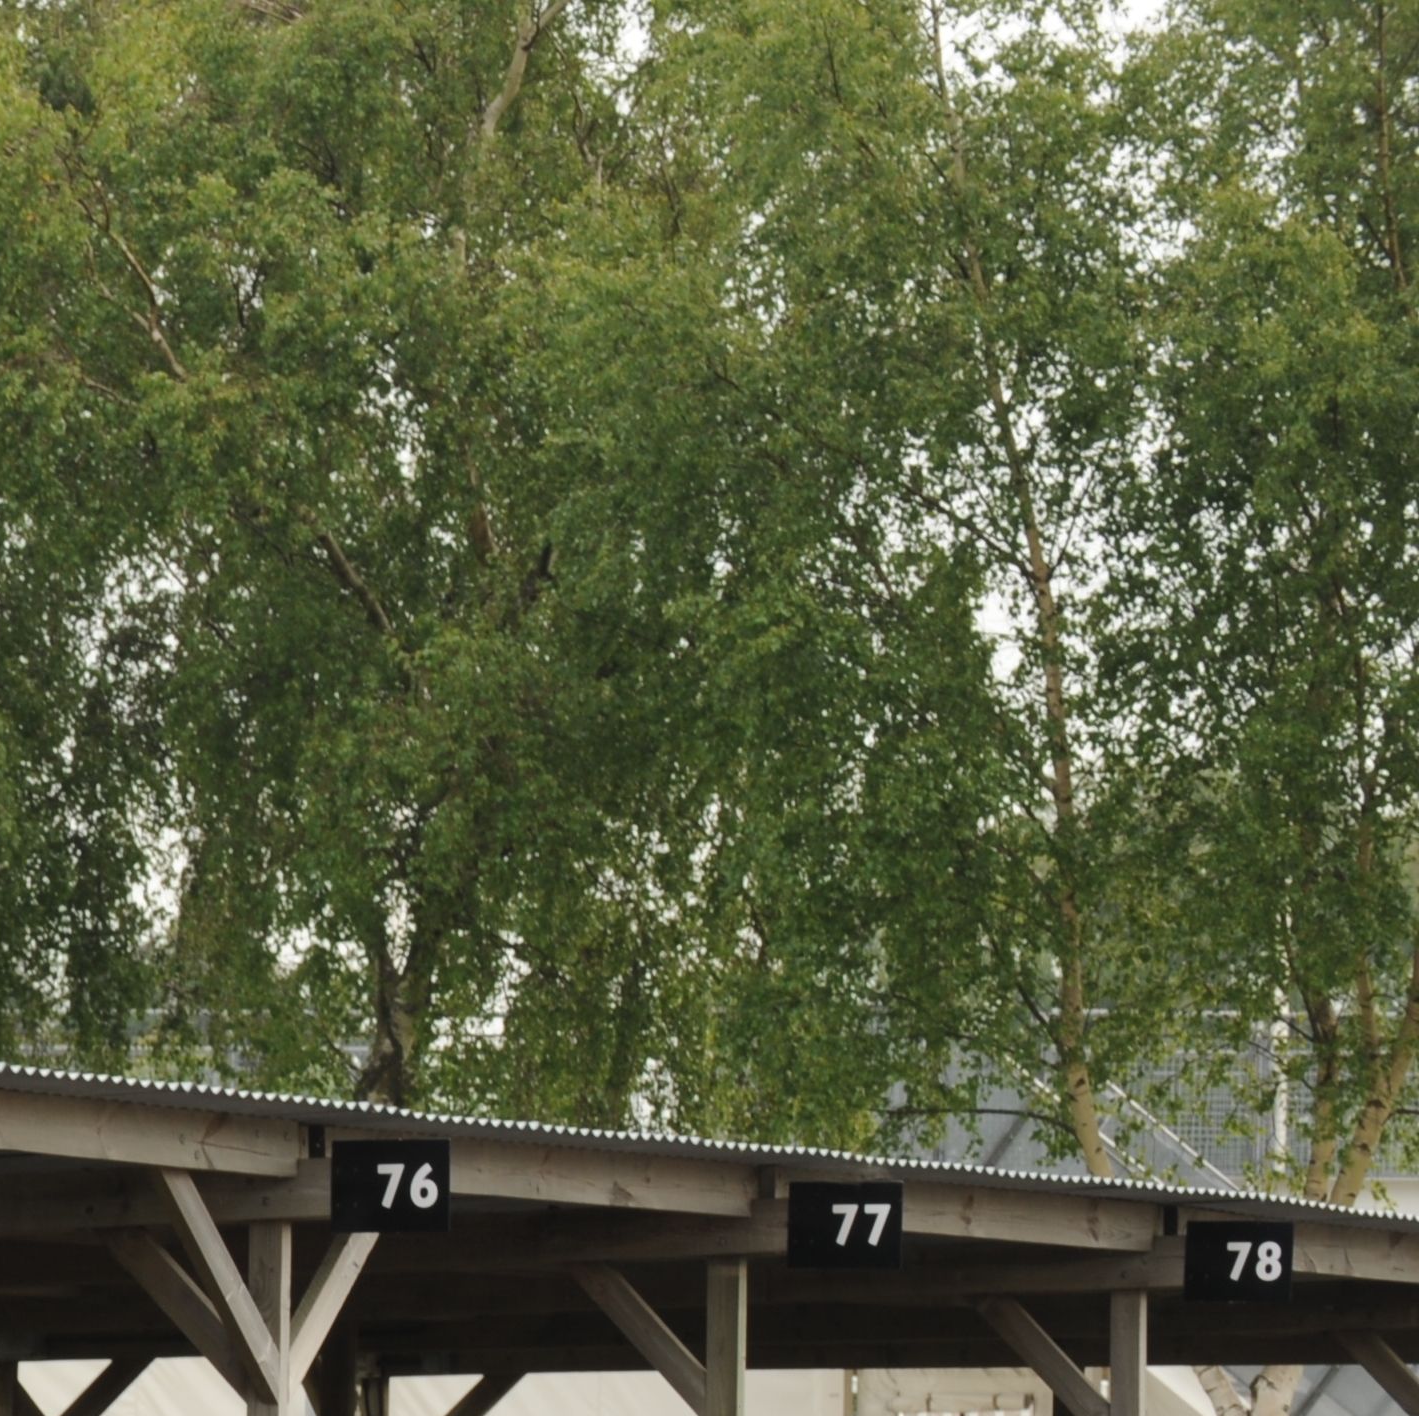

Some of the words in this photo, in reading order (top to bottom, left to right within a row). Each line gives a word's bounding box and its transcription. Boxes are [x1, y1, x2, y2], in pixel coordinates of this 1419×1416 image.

[377, 1162, 439, 1209] 76
[832, 1203, 892, 1247] 77
[1226, 1240, 1282, 1282] 78
